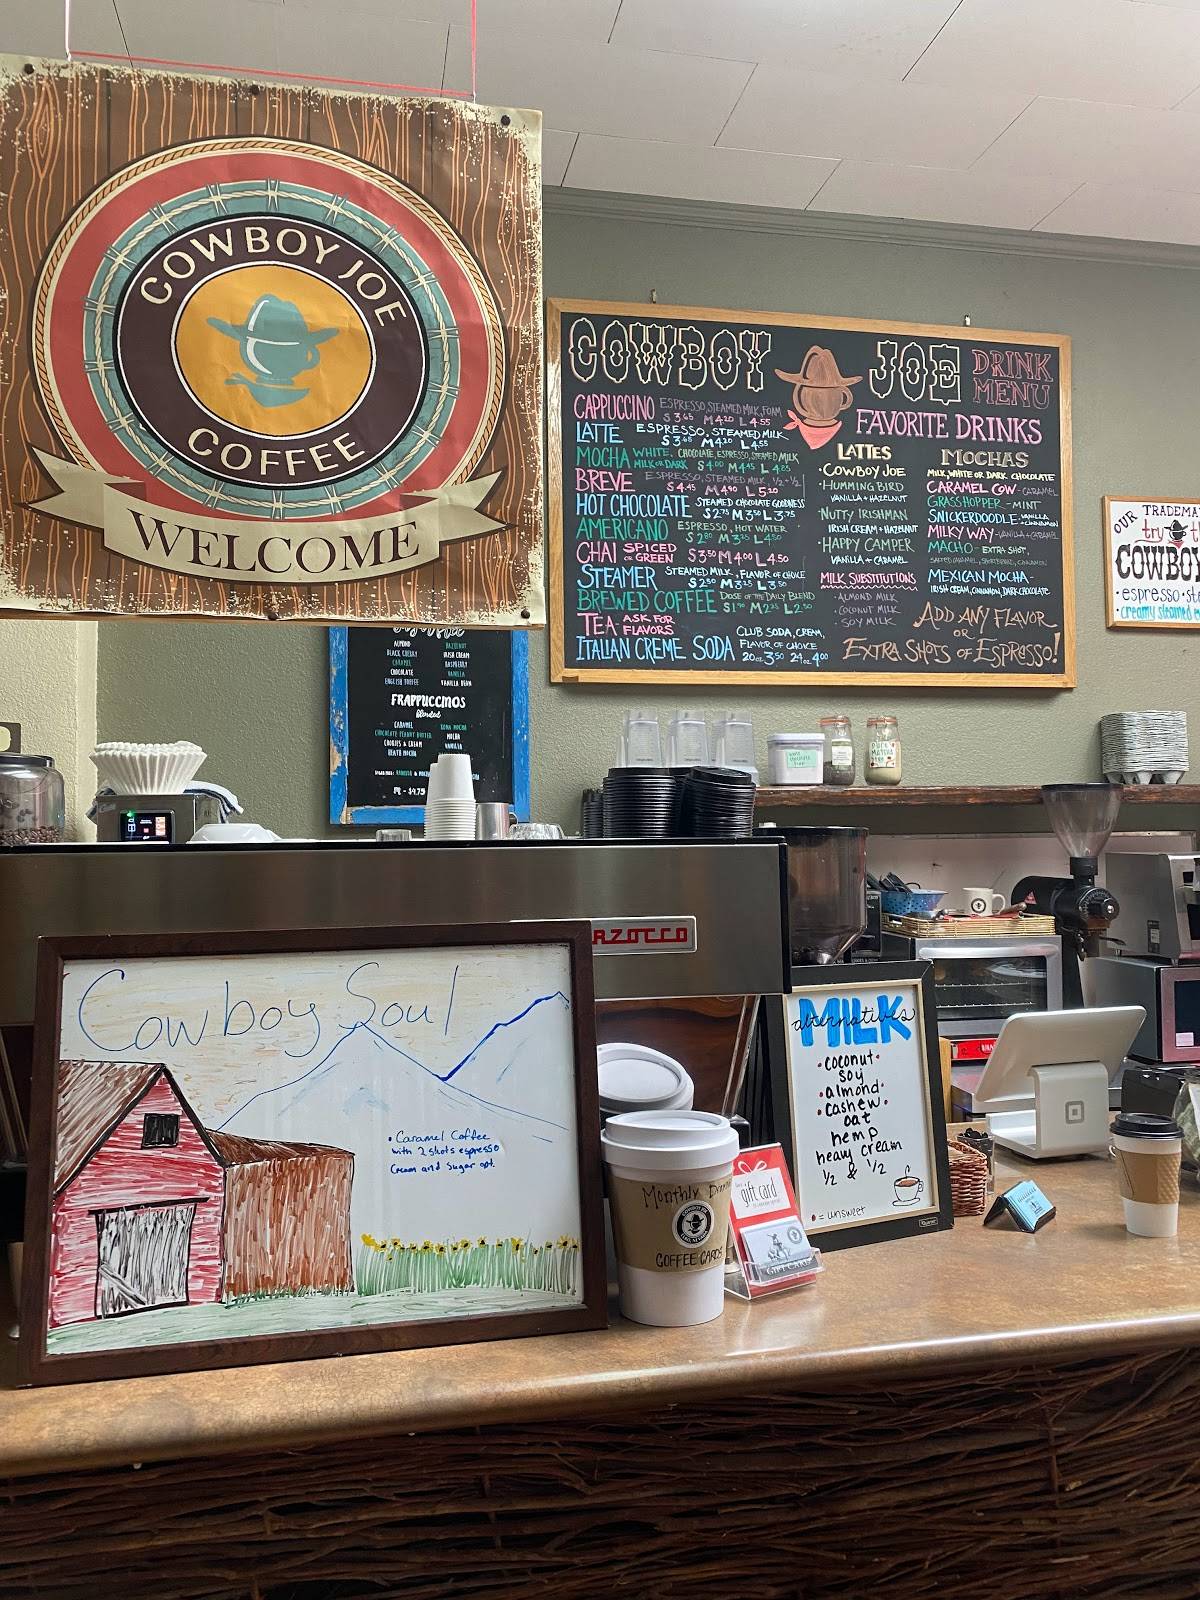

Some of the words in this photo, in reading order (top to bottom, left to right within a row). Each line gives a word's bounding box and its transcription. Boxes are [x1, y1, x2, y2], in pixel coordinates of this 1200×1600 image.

[140, 226, 341, 306] COWBOY
[340, 258, 408, 328] JOE
[569, 317, 772, 392] COWBOY
[869, 340, 961, 406] JOE
[972, 349, 1054, 382] DRINK
[972, 377, 1051, 409] MENU
[573, 393, 655, 421] CAPPUCCINO
[576, 421, 624, 444] LATTE
[711, 427, 760, 440] STEAMED
[761, 429, 789, 441] MILK
[856, 408, 949, 439] FAVORITE
[955, 413, 1042, 444] DRINKS
[188, 427, 366, 477] COFFEE
[576, 445, 631, 469] MOCHA
[837, 443, 892, 460] LATTES
[941, 448, 1029, 468] MOCHAS
[634, 459, 655, 468] MILK
[665, 459, 688, 470] DARK
[822, 462, 881, 480] COWBOY
[882, 463, 906, 477] JOE
[575, 467, 636, 492] BREVE
[704, 473, 746, 484] STEAMED
[822, 479, 875, 492] HUMMING
[876, 481, 904, 492] BIRD
[926, 480, 989, 495] CARAMEL
[991, 482, 1017, 496] COW
[576, 493, 607, 516] HOT
[610, 493, 693, 518] CHOCOLATE
[695, 496, 734, 507] STEAMED
[927, 495, 1007, 509] GRASSHOPPER
[819, 506, 855, 523] NUTTY
[858, 508, 909, 521] IRISHMAN
[927, 508, 1018, 526] SNICKERDOODLE
[1113, 510, 1138, 534] OUR
[1142, 504, 1200, 518] TRADEMA
[575, 517, 669, 541] AMERICANO
[735, 523, 752, 532] HOT
[754, 524, 788, 533] WATER
[927, 524, 965, 539] MILKY
[966, 527, 995, 543] WAY
[1135, 518, 1164, 543] try
[127, 508, 420, 574] WELCOME
[822, 536, 861, 553] HAPPY
[864, 537, 916, 553] CAMPER
[927, 540, 973, 554] MACHO
[576, 541, 617, 564] CHAI
[622, 542, 677, 553] SPICED
[635, 552, 674, 563] GREEN
[576, 564, 658, 591] STEAMER
[664, 565, 709, 577] STEAMED
[740, 569, 772, 580] FLAVOR
[781, 570, 806, 579] CHOICE
[820, 571, 847, 585] MILK
[848, 571, 917, 585] SUBSTITUTIONS
[927, 568, 985, 583] MEXICAN
[988, 570, 1030, 584] MOCHA
[576, 588, 650, 613] BREWED
[654, 588, 718, 613] COFFEE
[837, 592, 873, 603] ALMOND
[875, 593, 899, 603] MILK
[1122, 588, 1180, 604] espresso
[622, 613, 651, 623] ASK
[652, 614, 675, 624] FOR
[838, 605, 875, 616] COCONUT
[877, 605, 901, 614] MILK
[912, 601, 955, 630] ADD
[958, 605, 990, 634] ANY
[994, 608, 1058, 630] FLAVOR
[1120, 605, 1156, 620] creamy
[1158, 604, 1192, 621] steamed
[622, 624, 675, 636] FLAVORS
[736, 625, 764, 637] CLUB
[840, 617, 863, 628] SOY
[866, 617, 897, 626] MILK
[953, 628, 975, 640] OR
[575, 635, 631, 662] ITALIAN
[635, 637, 687, 664] CREME
[692, 635, 736, 661] SODA
[842, 637, 902, 662] EXTRA
[904, 638, 951, 665] SHOTS
[956, 648, 974, 661] OF
[78, 968, 321, 1058] Cowboy
[338, 961, 459, 1036] Soul
[791, 1007, 916, 1032] alternatives
[799, 994, 912, 1048] MILK
[824, 1049, 874, 1071] coconut
[838, 1068, 864, 1085] soy
[825, 1081, 880, 1099] almond
[825, 1096, 881, 1117] cashew
[843, 1110, 871, 1127] oat
[395, 1130, 445, 1143] Caramel
[450, 1128, 491, 1141] Coffee
[830, 1126, 879, 1147] hemp
[391, 1147, 412, 1155] with
[417, 1146, 427, 1156] 2
[458, 1144, 500, 1159] espresso
[815, 1146, 853, 1166] heavy
[861, 1139, 903, 1157] cream
[421, 1161, 441, 1173] and
[642, 1185, 700, 1210] Monthly
[741, 1181, 758, 1208] gift
[758, 1176, 778, 1200] card
[827, 1206, 866, 1221] unsweet
[655, 1252, 697, 1268] COFFEE
